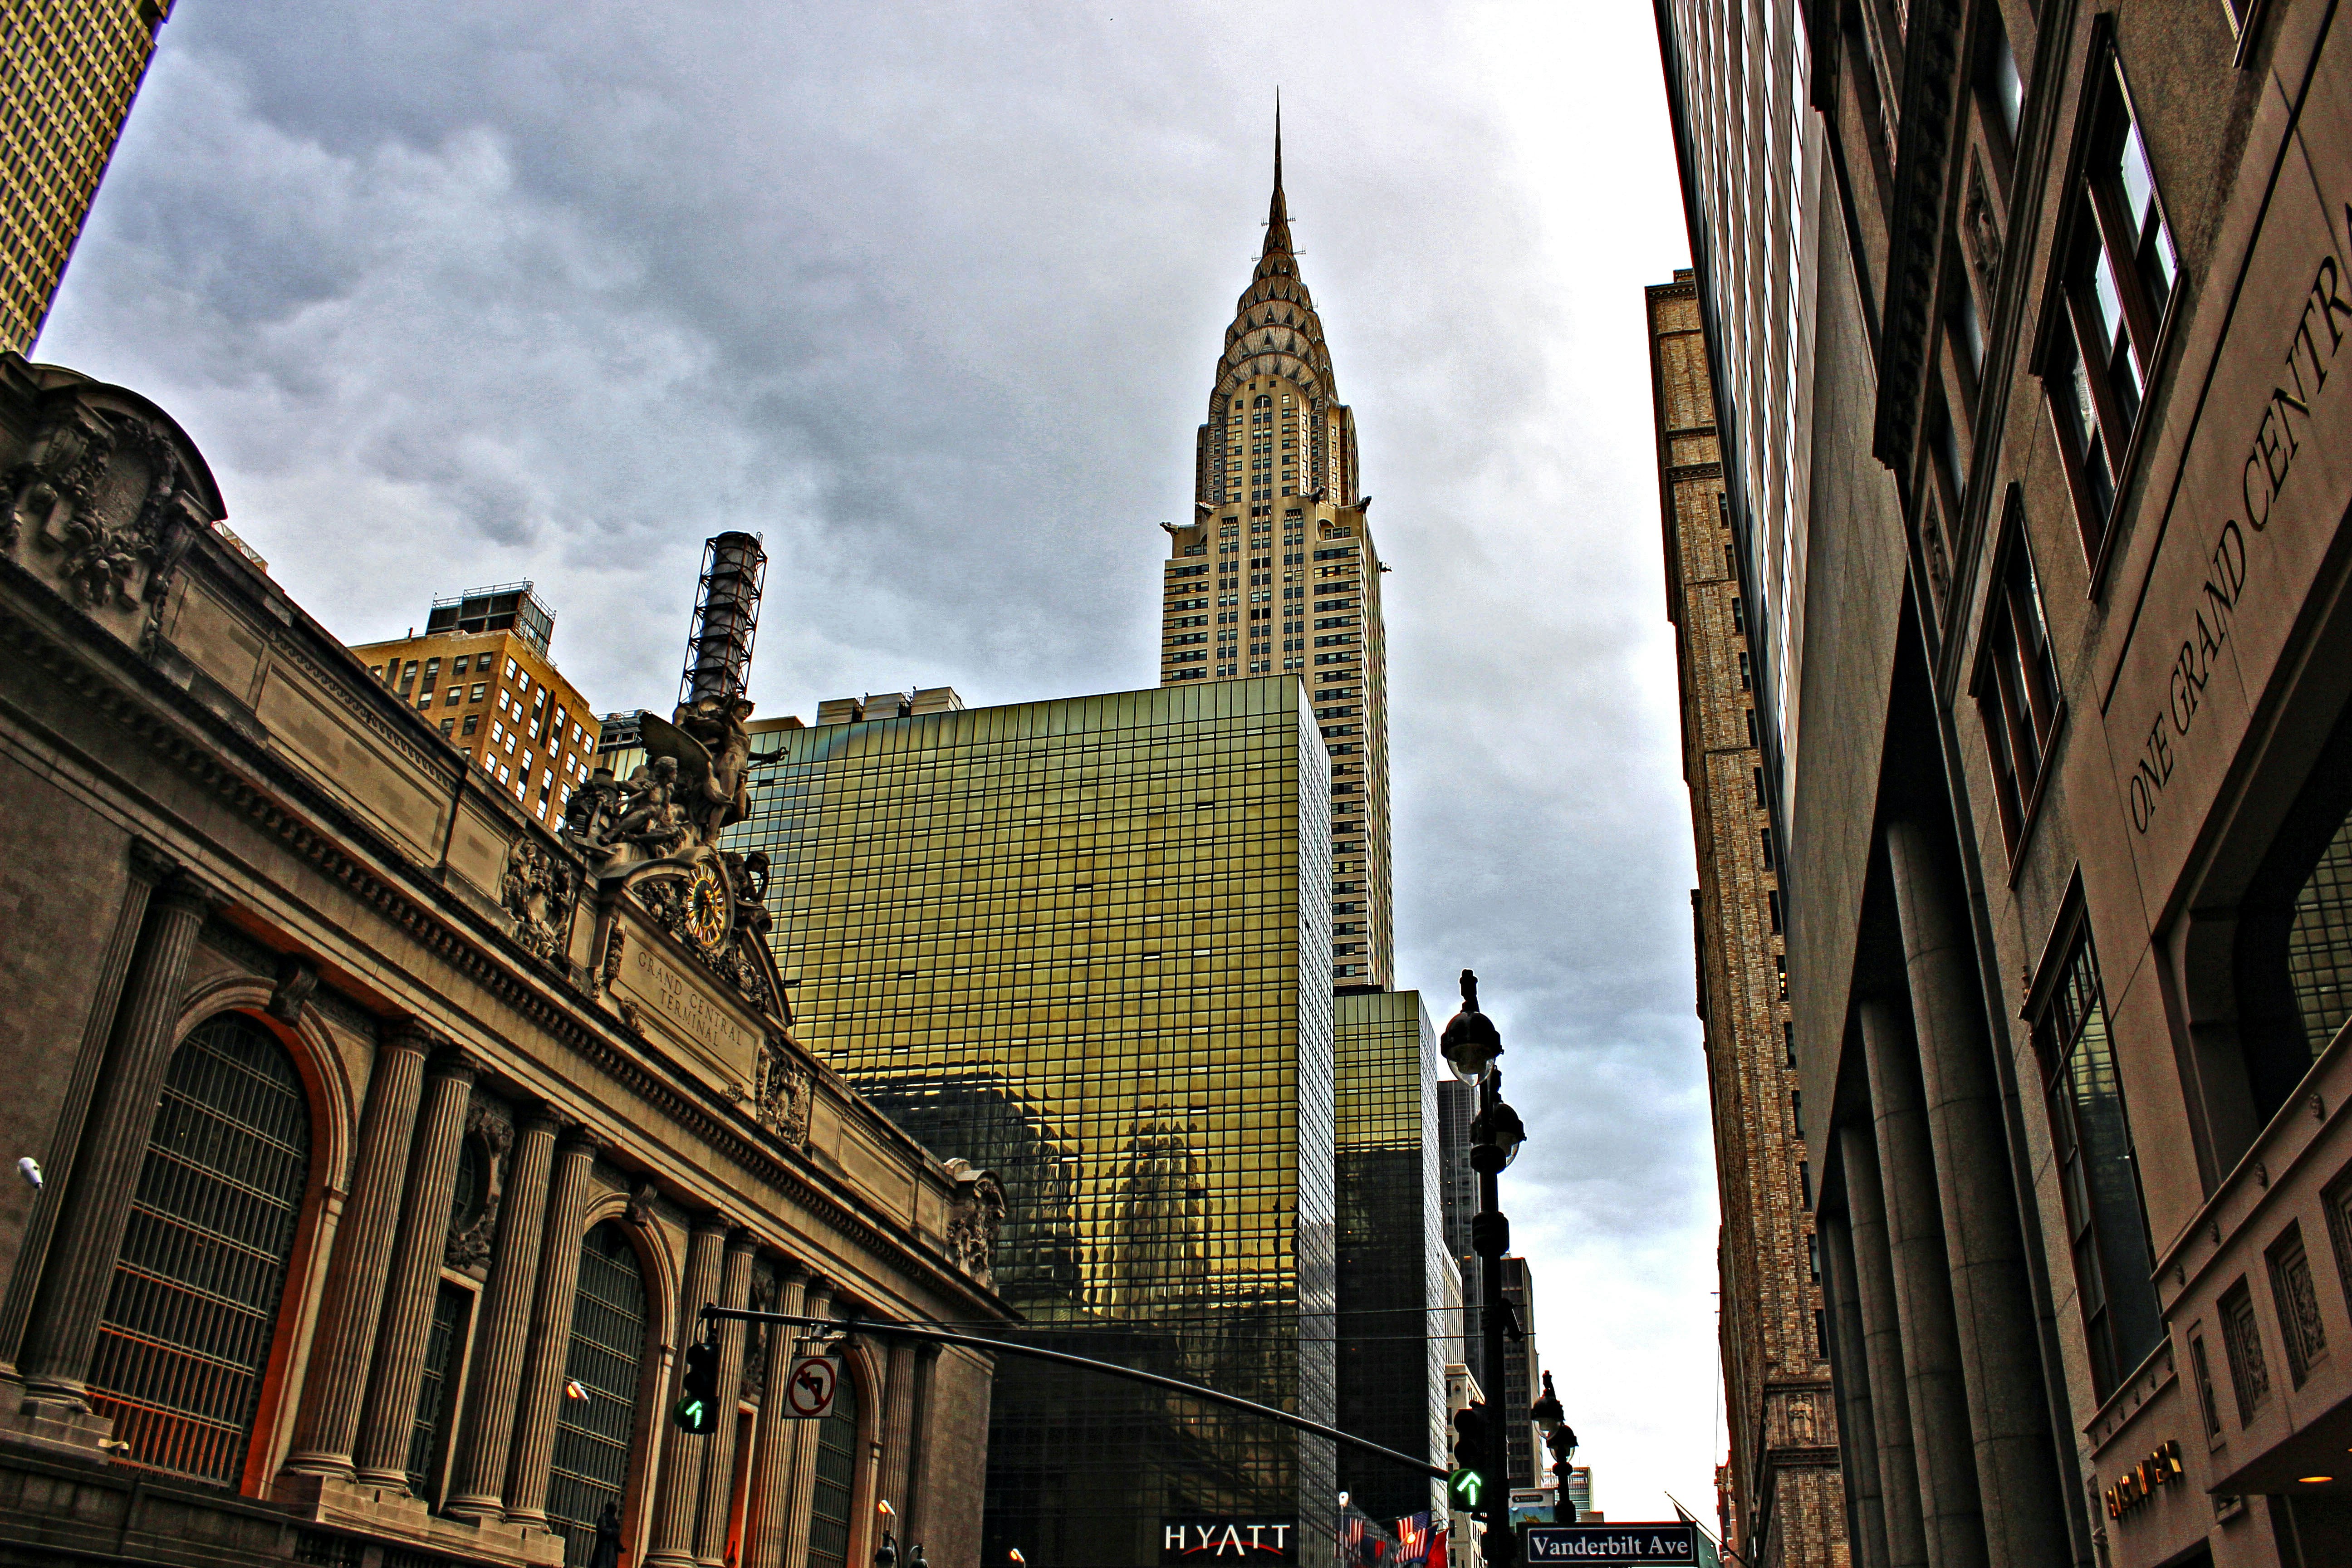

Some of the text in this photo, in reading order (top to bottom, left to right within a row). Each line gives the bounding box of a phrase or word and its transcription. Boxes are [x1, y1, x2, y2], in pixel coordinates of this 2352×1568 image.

[2130, 202, 2352, 835] ONE GRAND CENTR
[638, 951, 741, 1046] GRAND CENTRAL
[661, 988, 718, 1047] TERMINAL
[1165, 1524, 1291, 1557] HYATT
[1532, 1535, 1688, 1556] Vanderbilt Ave
